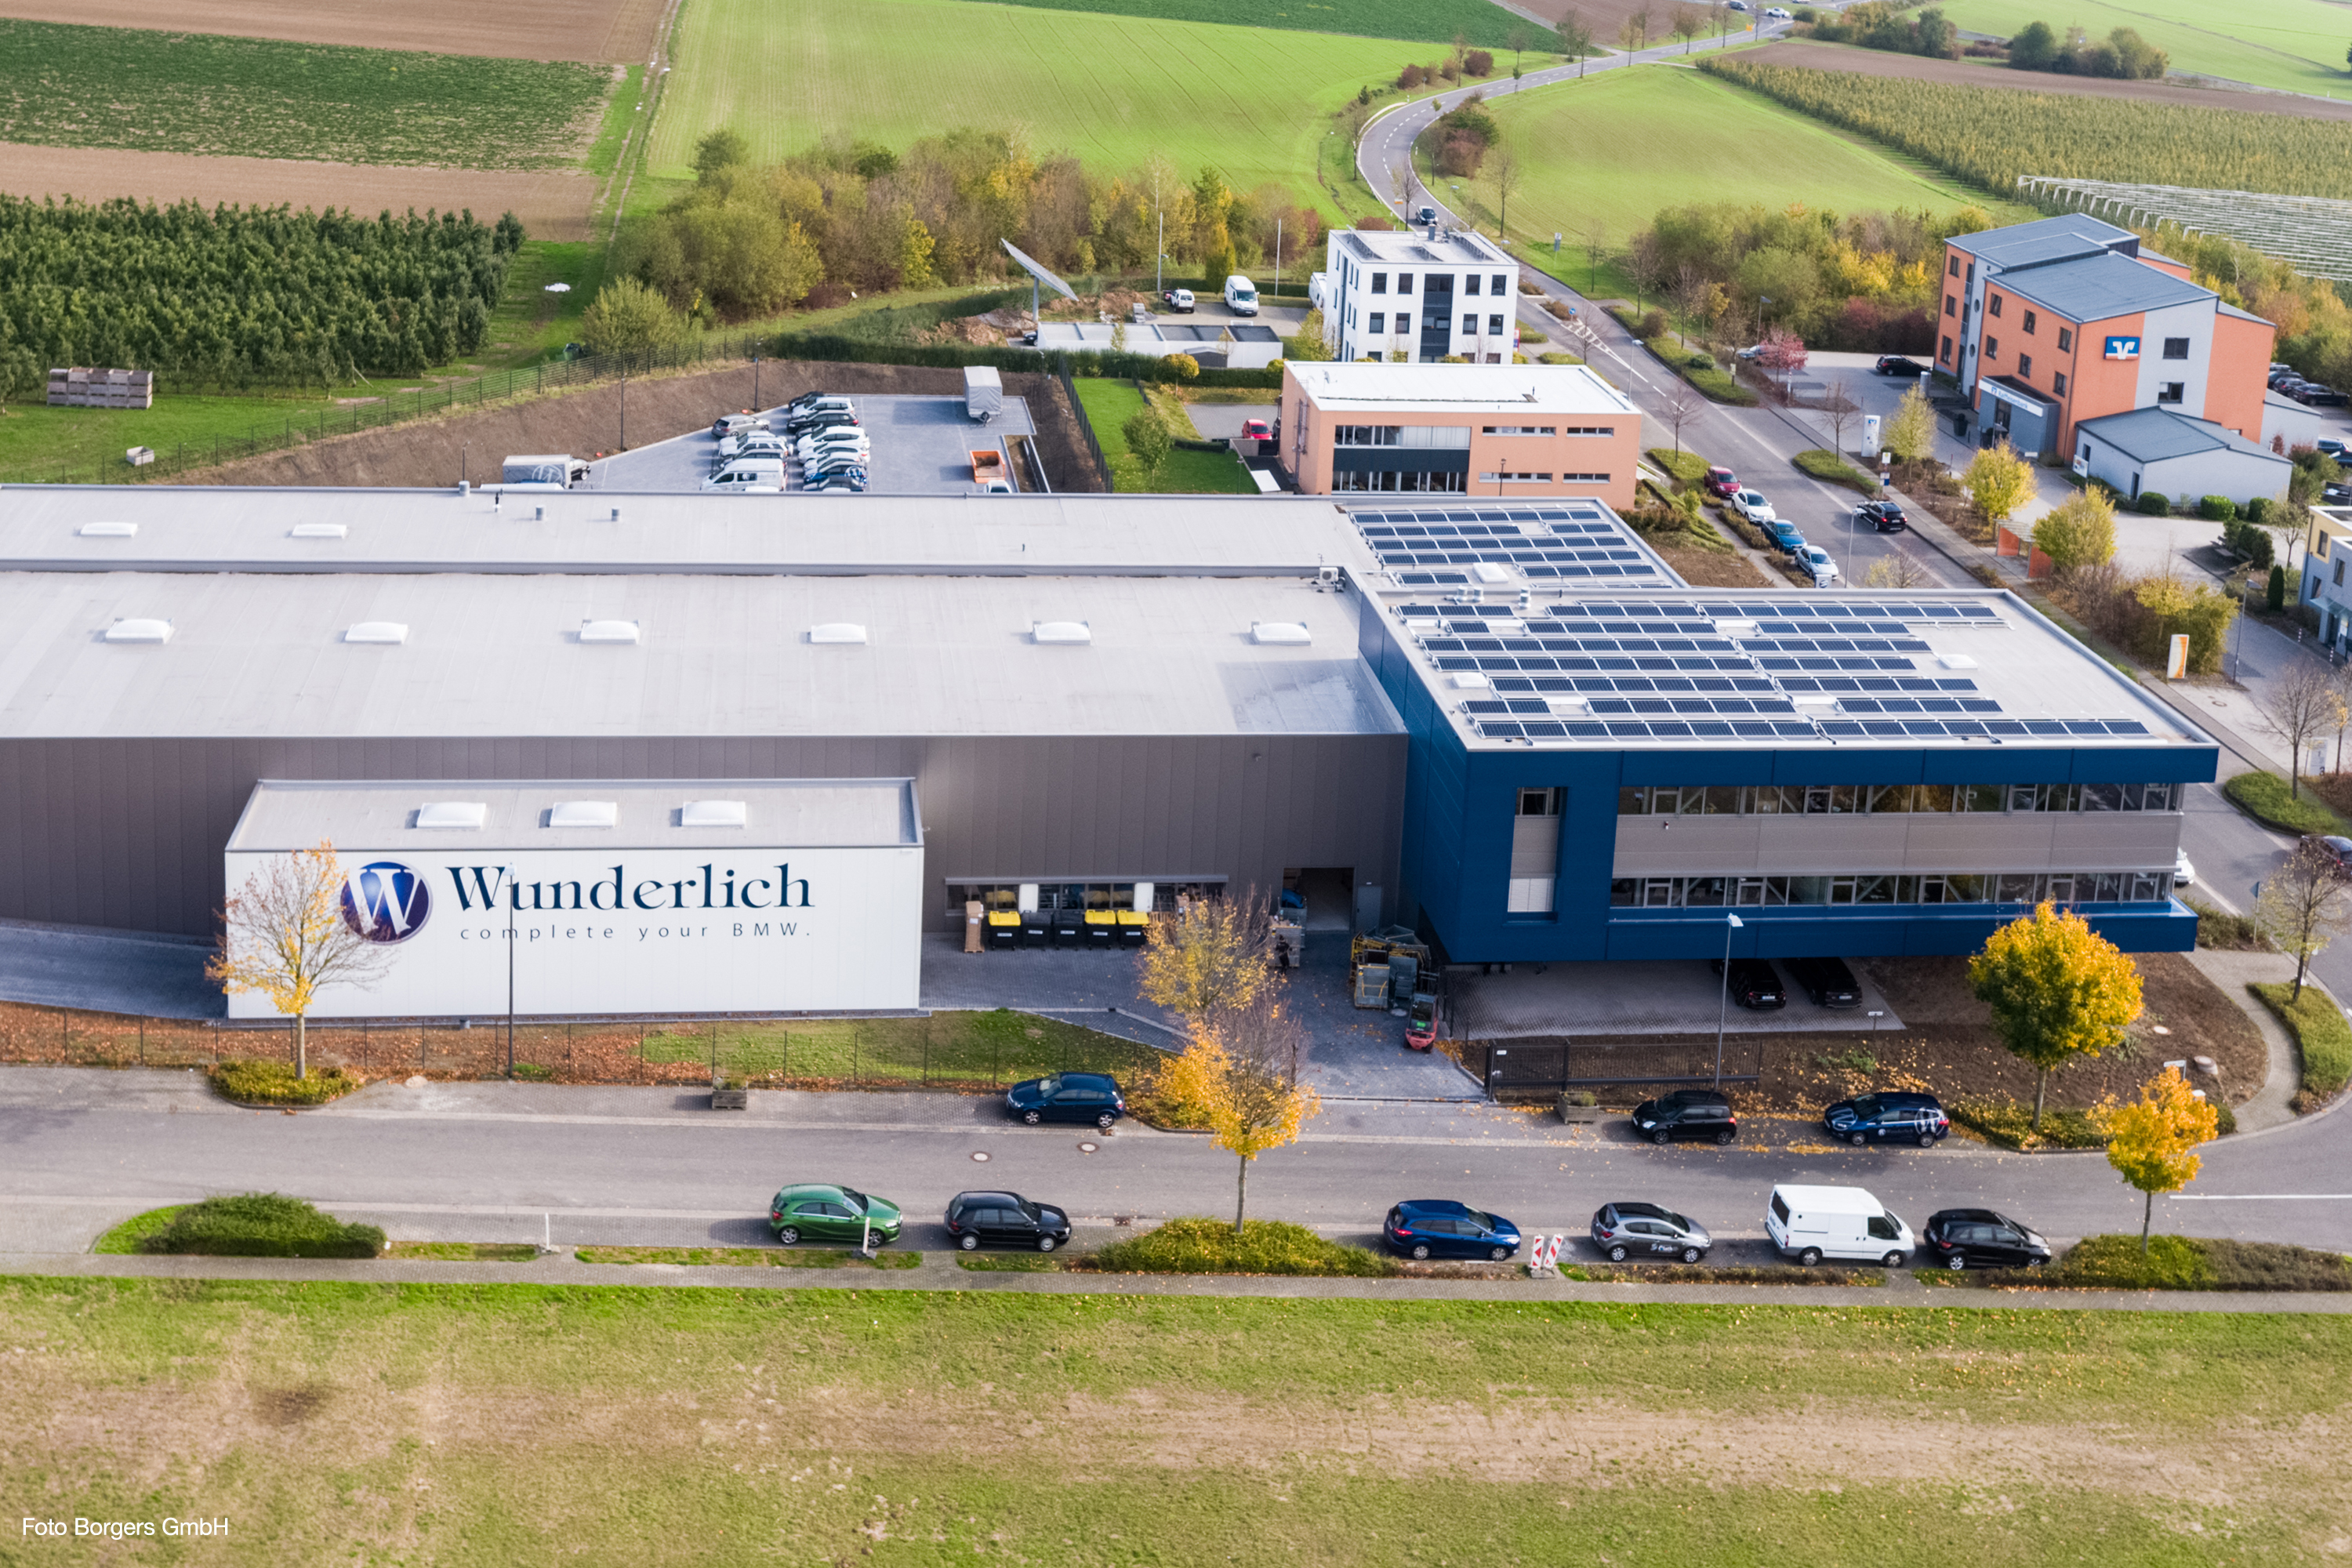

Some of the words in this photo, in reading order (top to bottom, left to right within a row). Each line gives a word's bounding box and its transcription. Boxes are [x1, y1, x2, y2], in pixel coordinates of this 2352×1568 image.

[445, 863, 815, 912] Wunderlich
[460, 924, 613, 942] complete
[638, 927, 708, 942] your
[733, 922, 810, 937] BMW.
